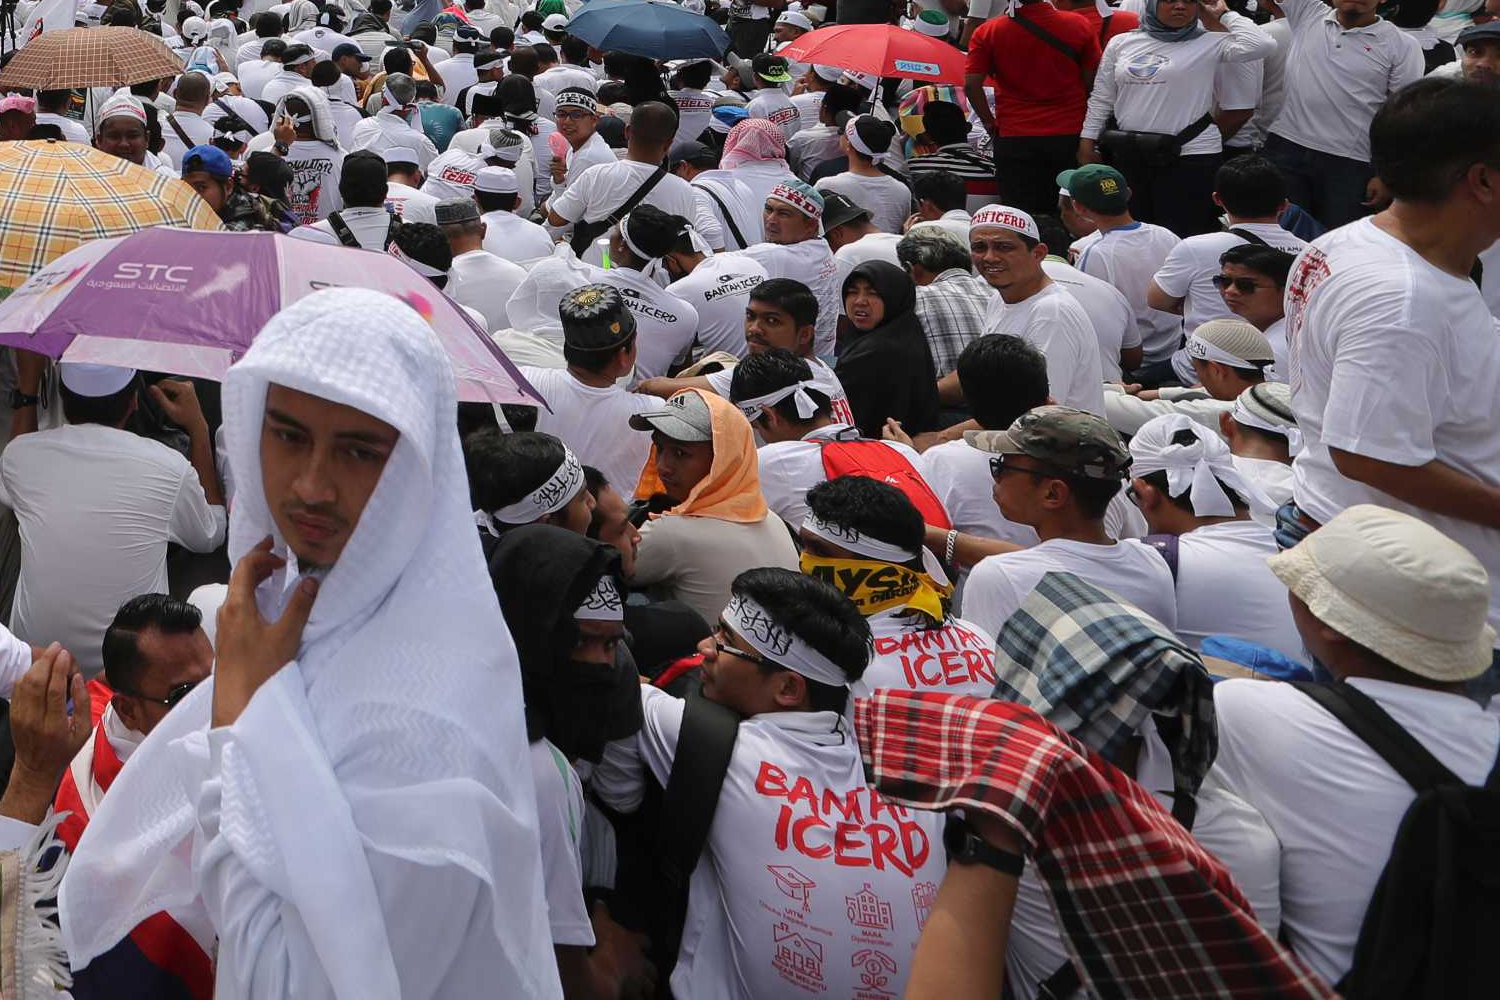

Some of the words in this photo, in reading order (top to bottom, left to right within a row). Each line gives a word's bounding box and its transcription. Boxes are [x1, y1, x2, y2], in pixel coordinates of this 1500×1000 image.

[990, 211, 1026, 229] ICERD
[113, 262, 194, 285] STC
[640, 306, 678, 324] ICERD
[775, 805, 930, 878] ICERD
